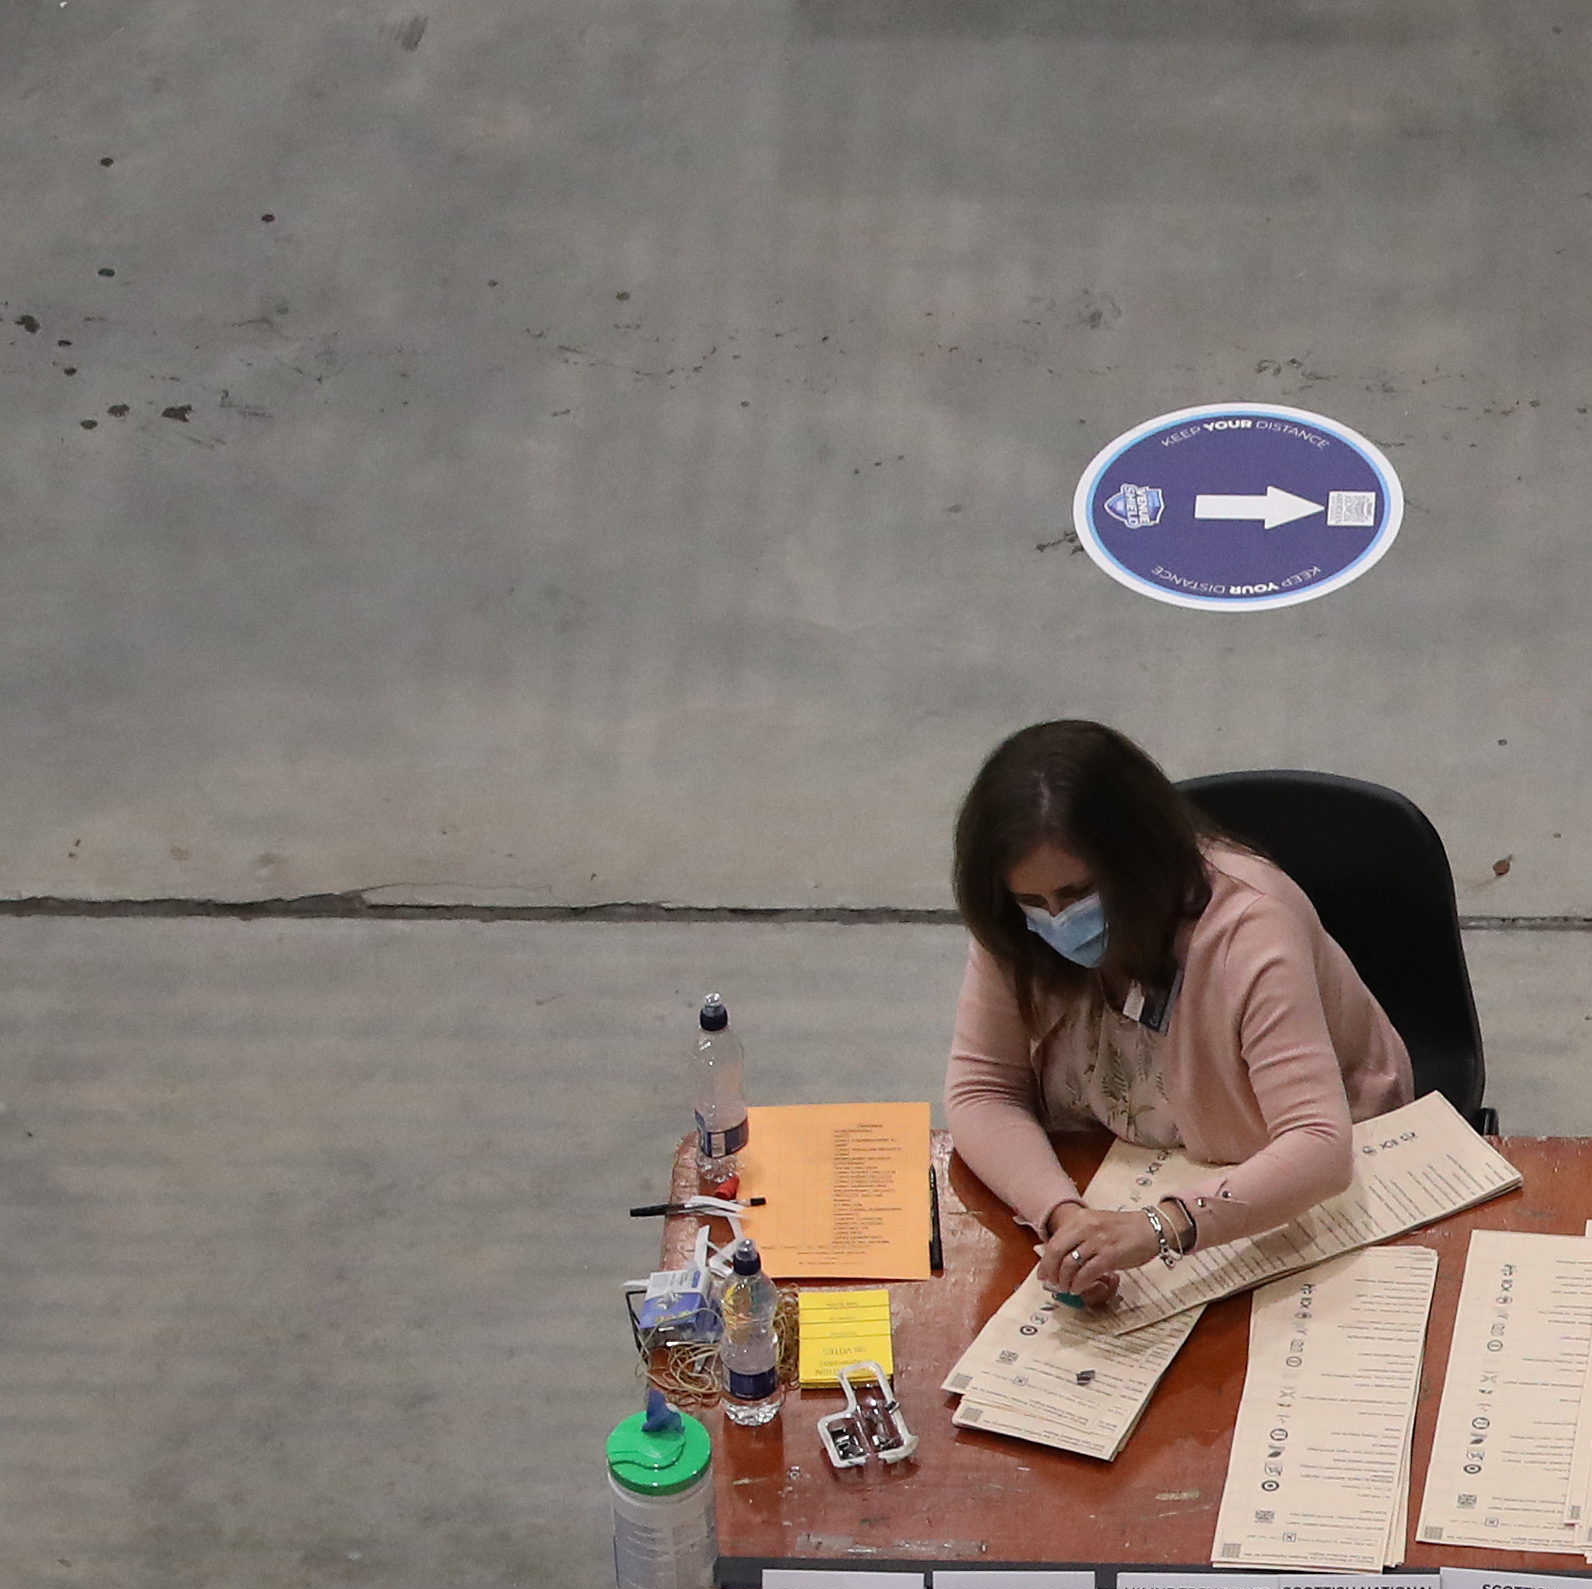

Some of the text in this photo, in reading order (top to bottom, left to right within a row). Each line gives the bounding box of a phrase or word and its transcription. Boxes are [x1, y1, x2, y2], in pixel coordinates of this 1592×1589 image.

[1161, 419, 1331, 450] KEEP YOUR DISTANCE
[1151, 564, 1321, 595] KEEP YOUR DISTANCE
